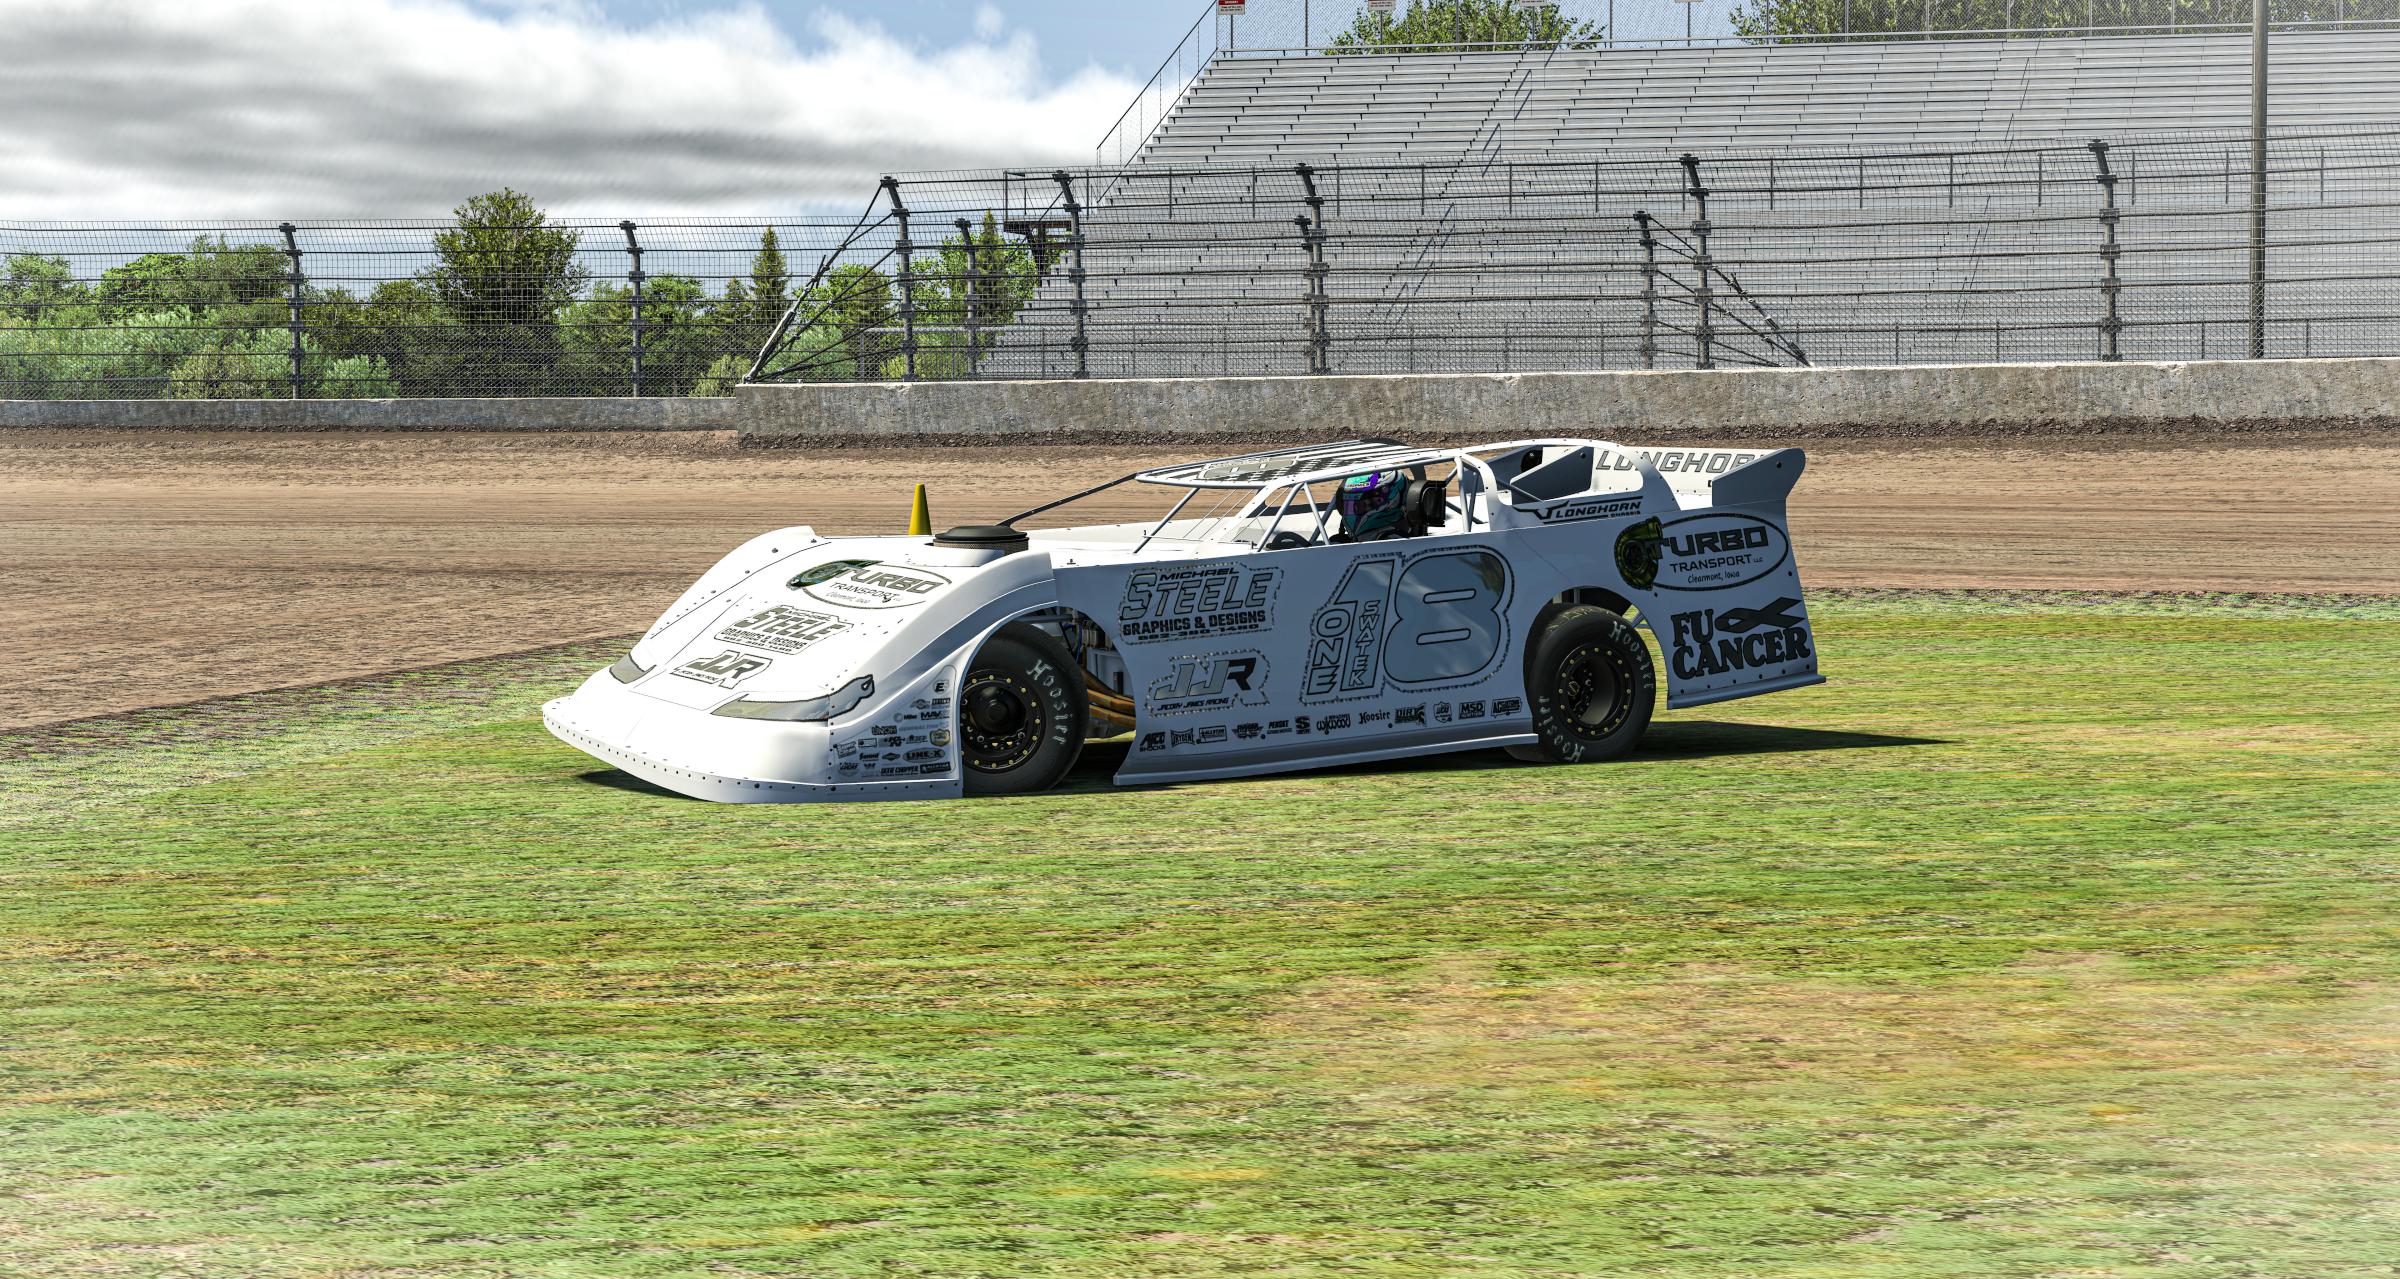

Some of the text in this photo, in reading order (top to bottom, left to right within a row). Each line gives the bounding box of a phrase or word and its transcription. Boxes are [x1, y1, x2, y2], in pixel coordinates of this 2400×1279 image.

[1596, 451, 1764, 473] LONGHOR
[1555, 502, 1641, 518] LONGHORN
[836, 566, 945, 595] TURBO
[1160, 568, 1240, 581] MICHAEL
[1670, 554, 1752, 574] TRANSPORT
[1121, 572, 1274, 620] STEELE
[733, 607, 847, 641] STEELE
[1123, 611, 1266, 636] GRAPHICS & DESIGNS
[1334, 552, 1506, 691] 18
[1671, 609, 1714, 647] FU
[1307, 608, 1351, 695] ONE
[1348, 600, 1382, 687] SWATEK
[1672, 627, 1811, 680] CANCER
[1154, 658, 1257, 700] JJR
[1027, 659, 1073, 745] Hoosier
[1359, 709, 1391, 724] Hoosier
[1461, 702, 1484, 713] MSD
